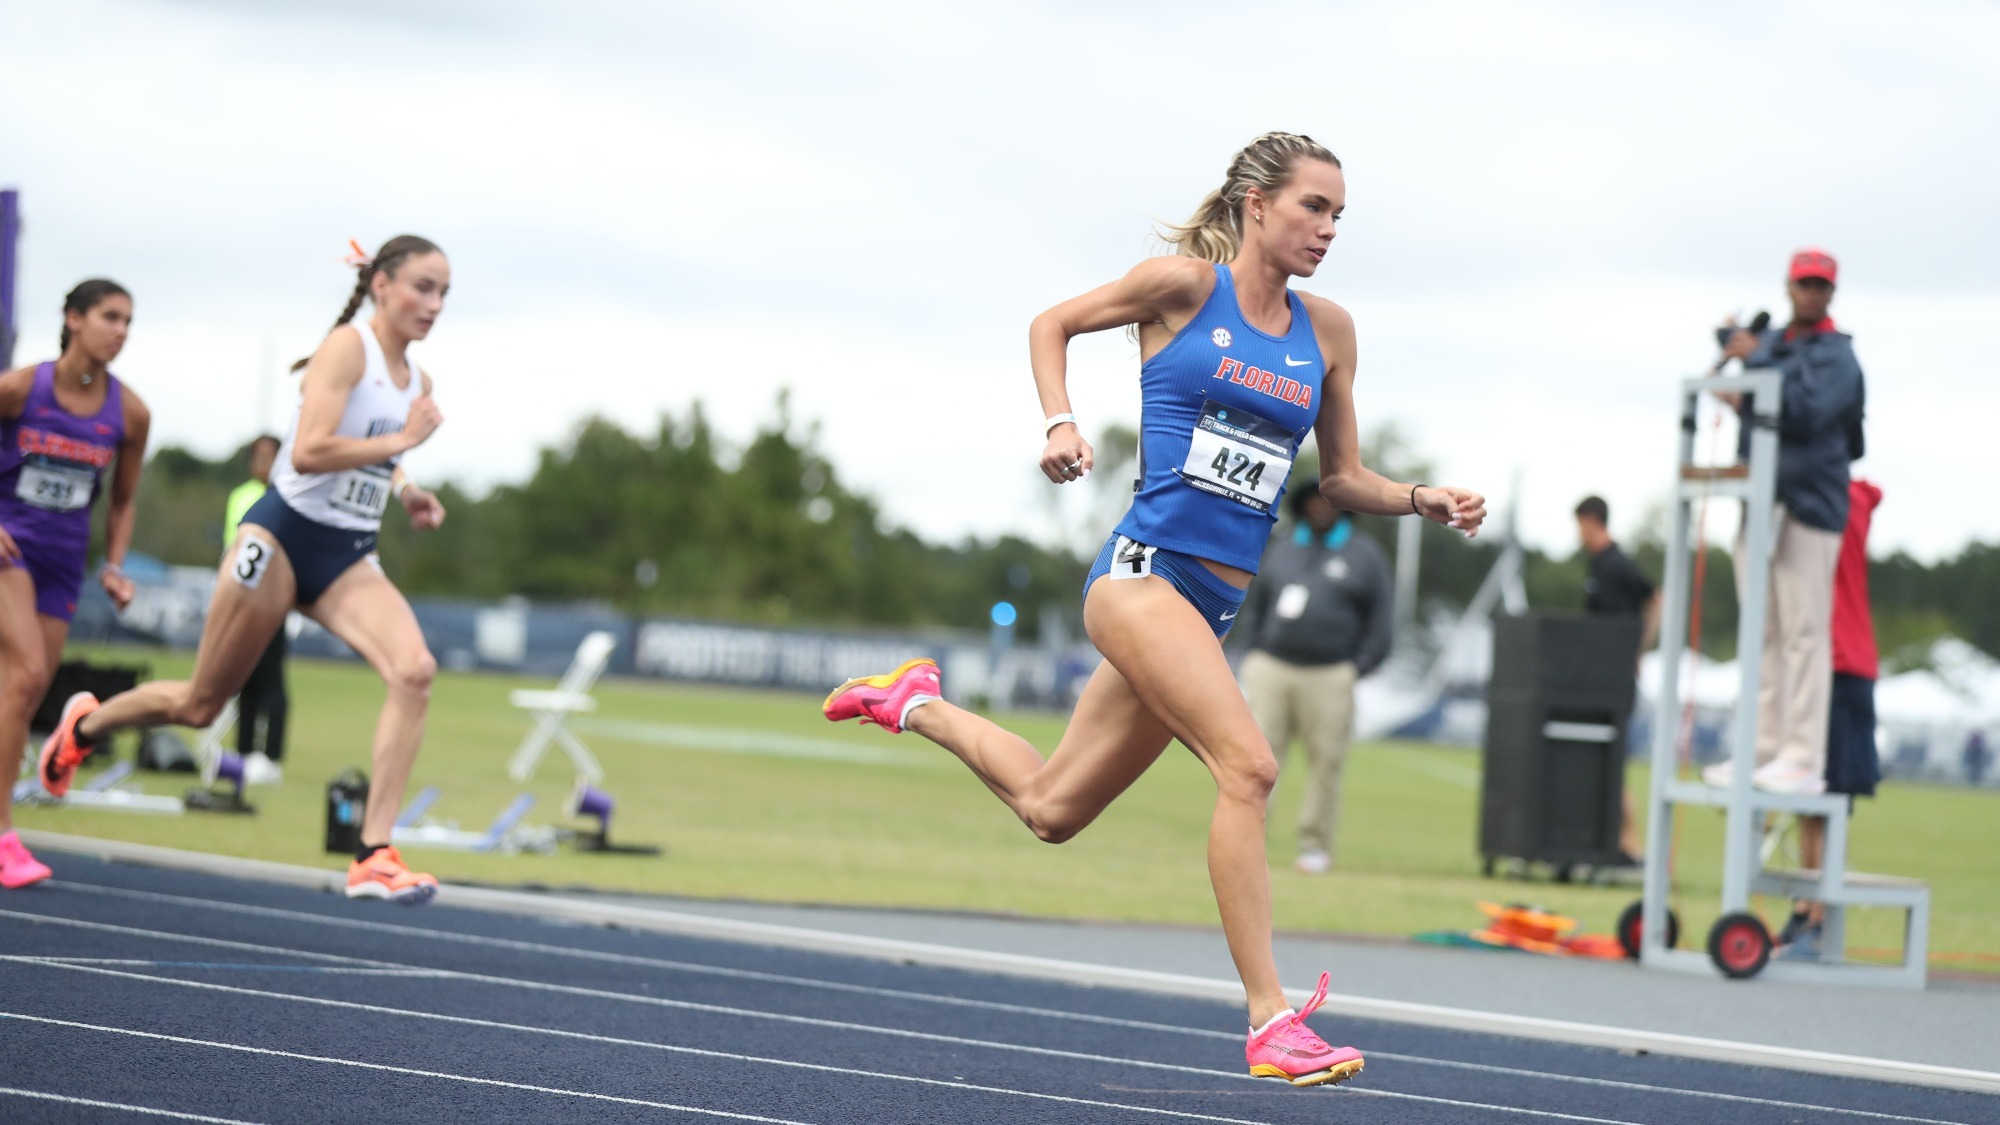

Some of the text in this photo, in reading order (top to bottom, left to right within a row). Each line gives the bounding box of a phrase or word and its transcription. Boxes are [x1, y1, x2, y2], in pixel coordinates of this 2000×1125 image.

[1211, 328, 1232, 347] SEC
[1212, 356, 1312, 409] FLORIDA
[1213, 420, 1230, 433] TRACK
[1233, 429, 1250, 440] FIELD
[1211, 446, 1266, 491] 424
[237, 543, 262, 580] 3
[1116, 540, 1146, 573] 4
